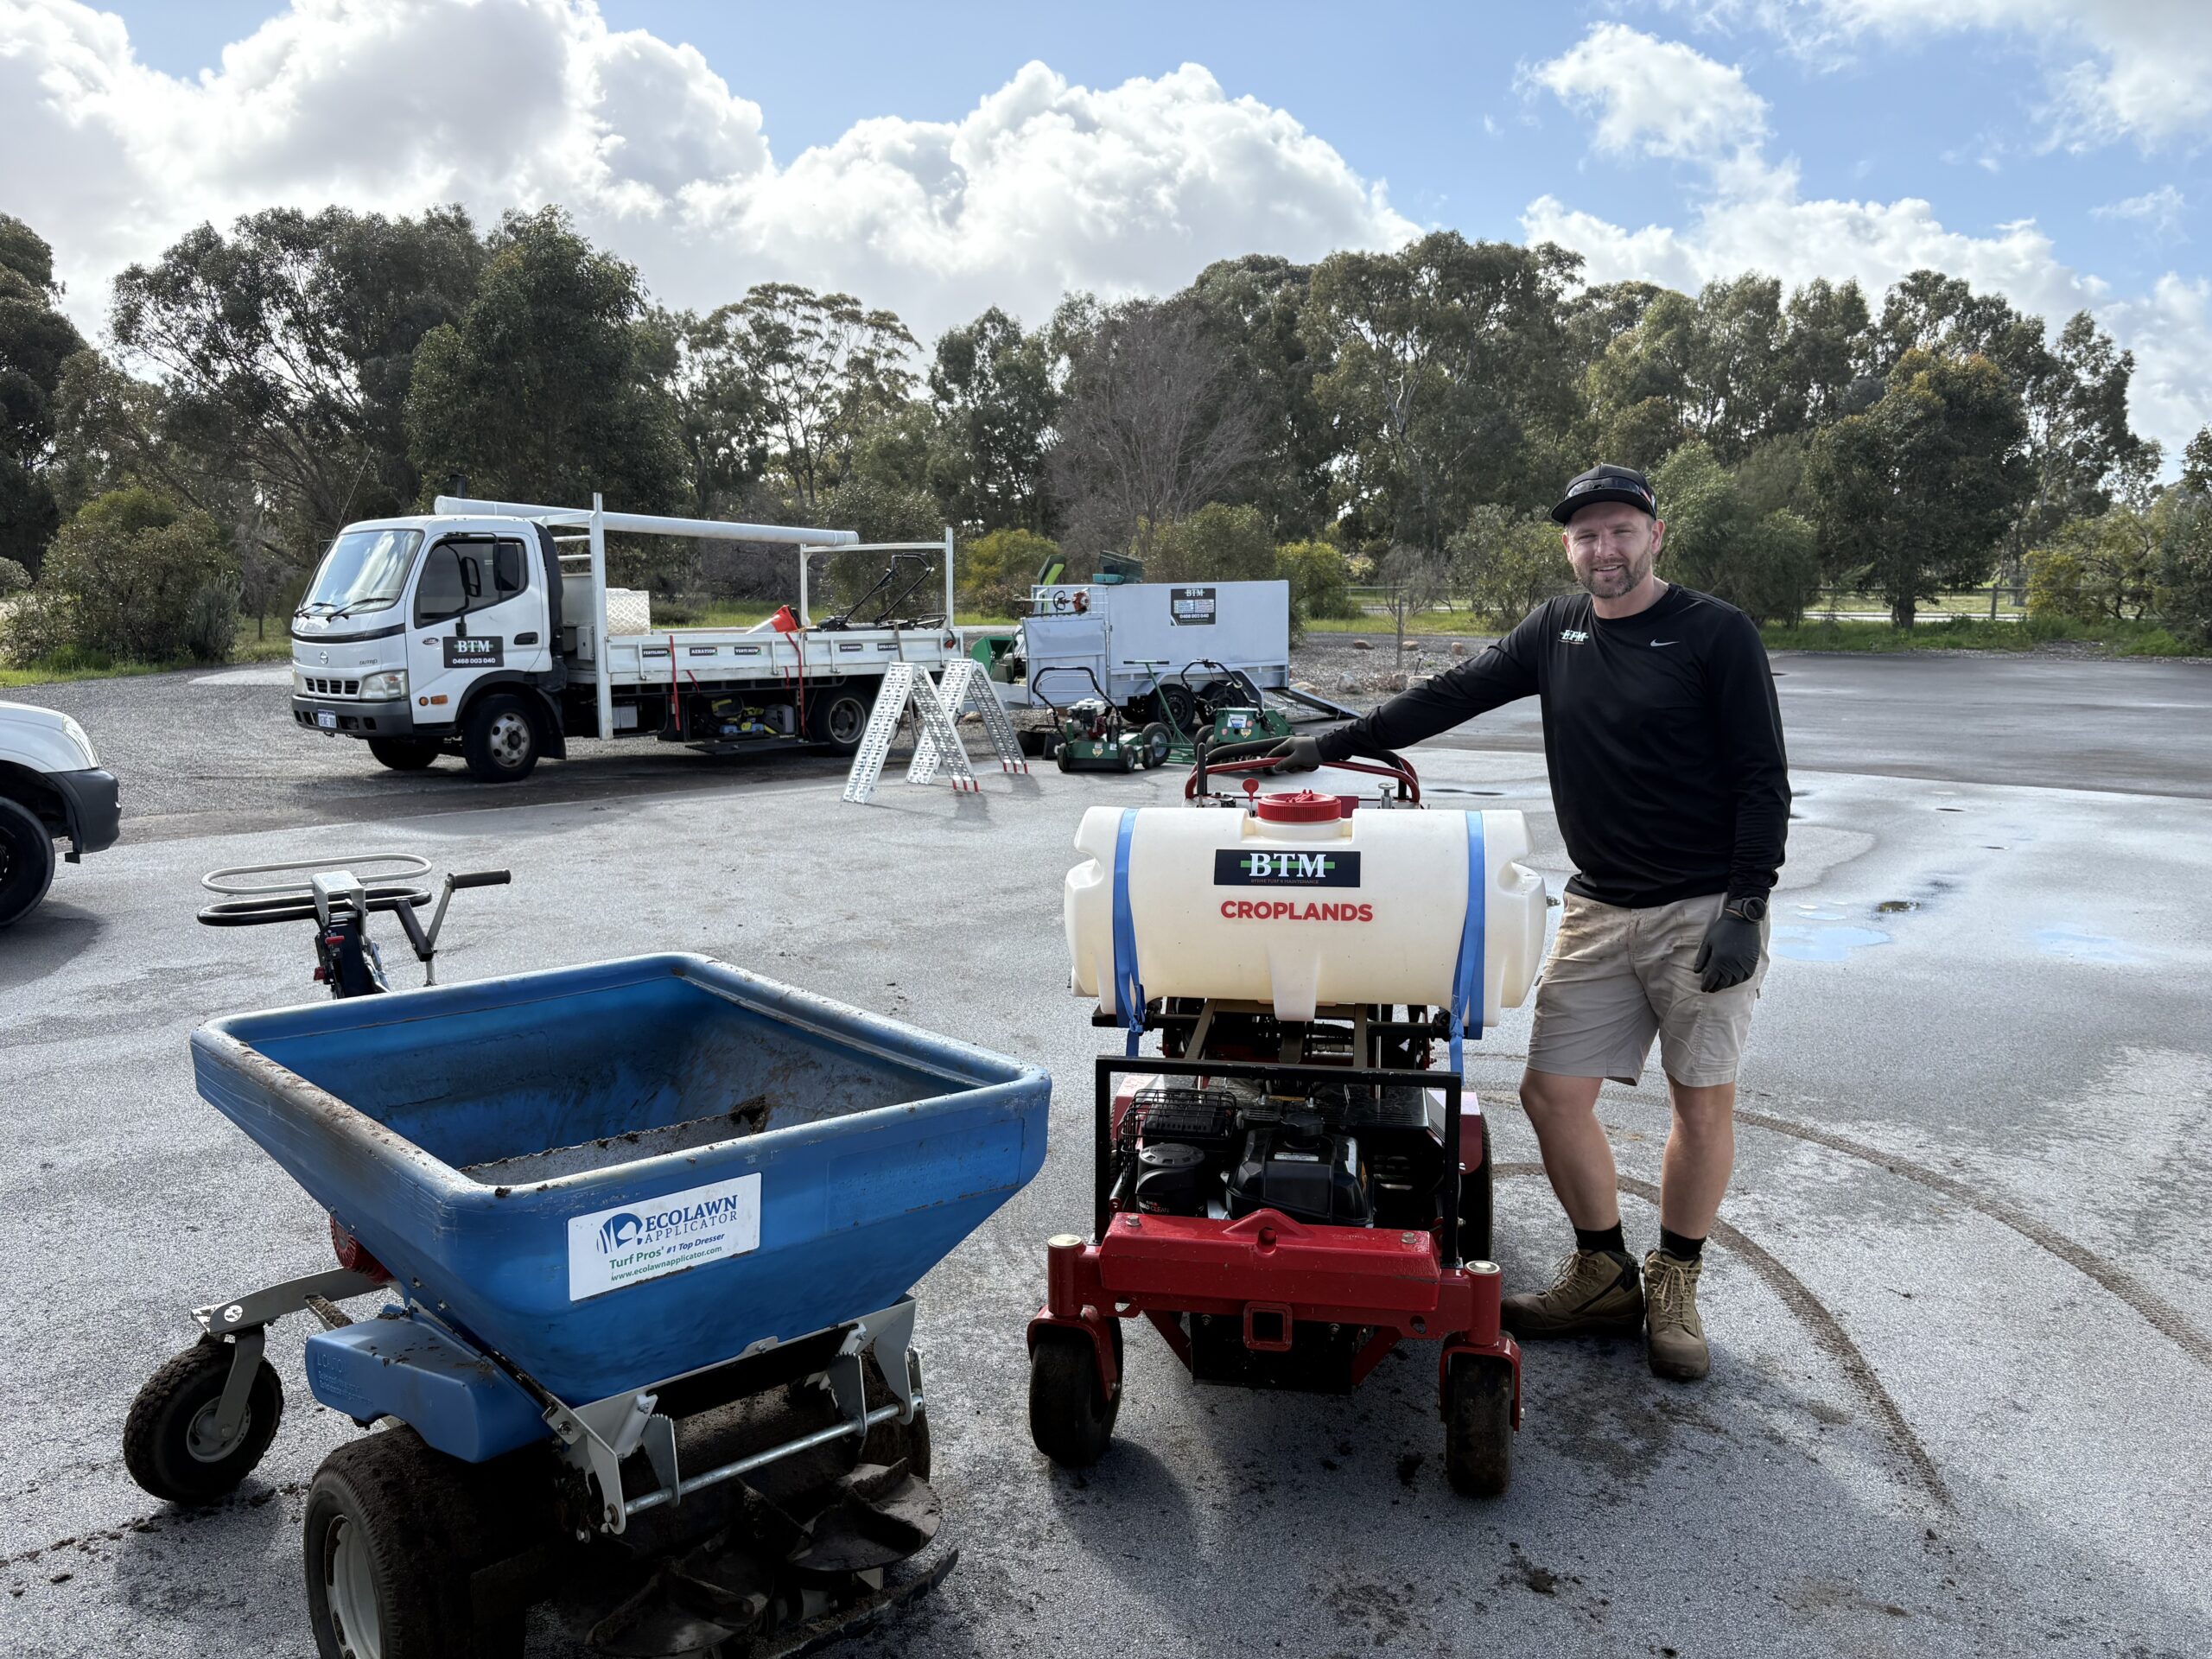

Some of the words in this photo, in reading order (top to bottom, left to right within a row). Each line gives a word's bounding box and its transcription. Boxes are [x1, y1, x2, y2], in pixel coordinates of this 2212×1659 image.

[457, 640, 490, 652] BTM
[1249, 853, 1326, 878] BTM
[1221, 900, 1373, 922] CROPLANDS
[645, 1195, 738, 1232] ECOLAWN
[645, 1211, 737, 1243] APPLICATOR
[609, 1255, 634, 1269] Turf
[636, 1246, 664, 1262] Pros'
[678, 1242, 693, 1251] Top
[695, 1234, 725, 1246] Dresser
[611, 1245, 722, 1281] www.ecolawnapplicator.com
